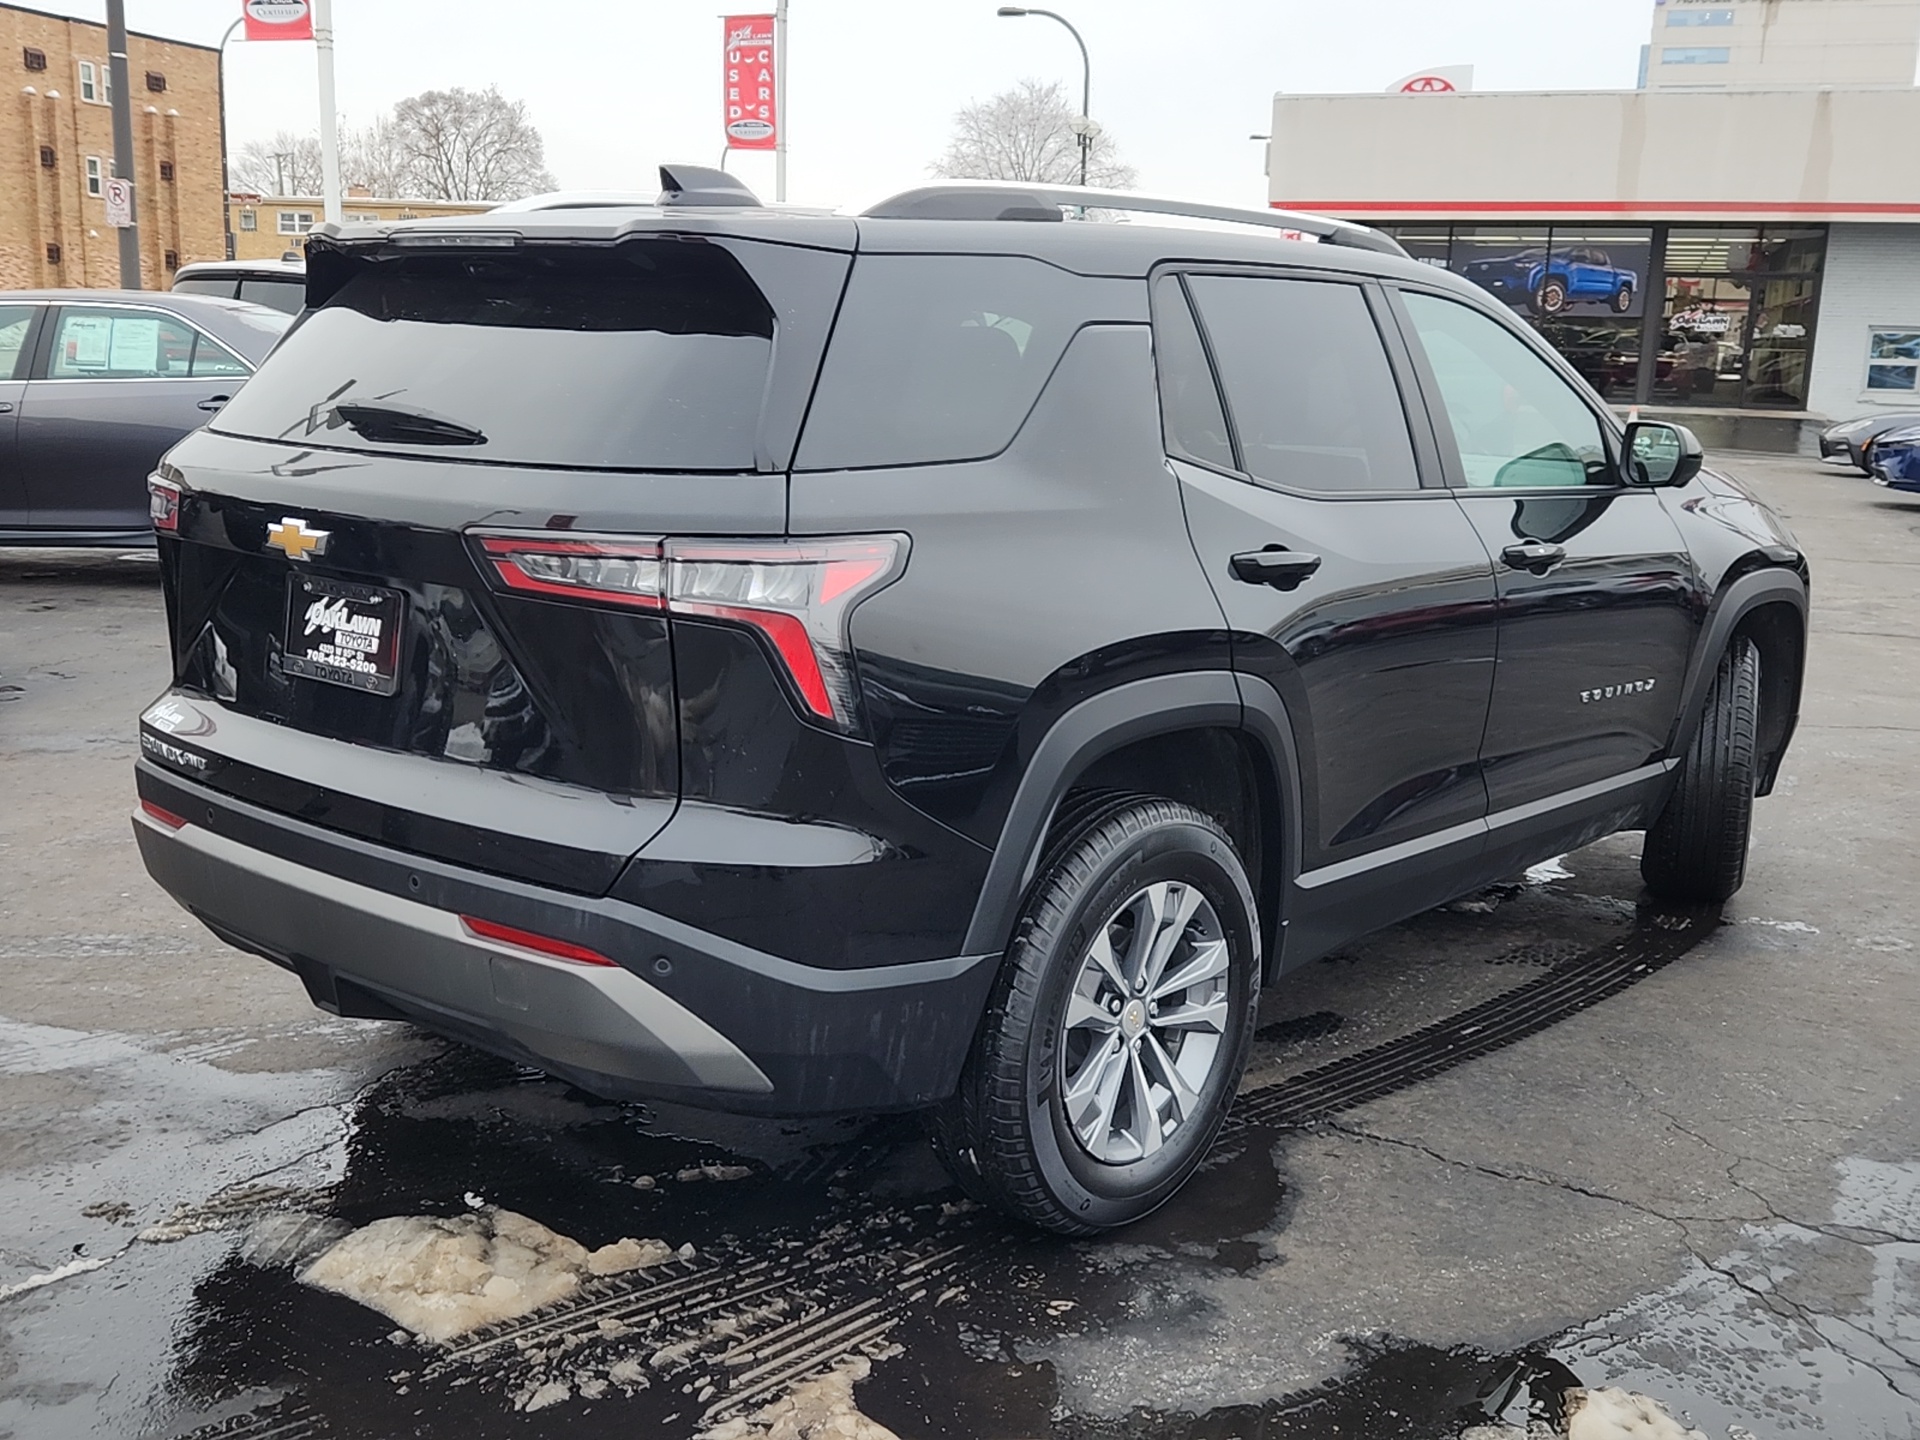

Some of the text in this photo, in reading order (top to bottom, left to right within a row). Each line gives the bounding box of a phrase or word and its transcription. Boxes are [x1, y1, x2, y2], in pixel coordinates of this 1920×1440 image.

[729, 50, 742, 119] USED
[758, 49, 771, 119] CARS
[339, 633, 374, 651] TOYOTA
[306, 648, 378, 674] 708-423-5200
[314, 665, 355, 685] TOYOTA
[1579, 678, 1656, 703] EQUINOX
